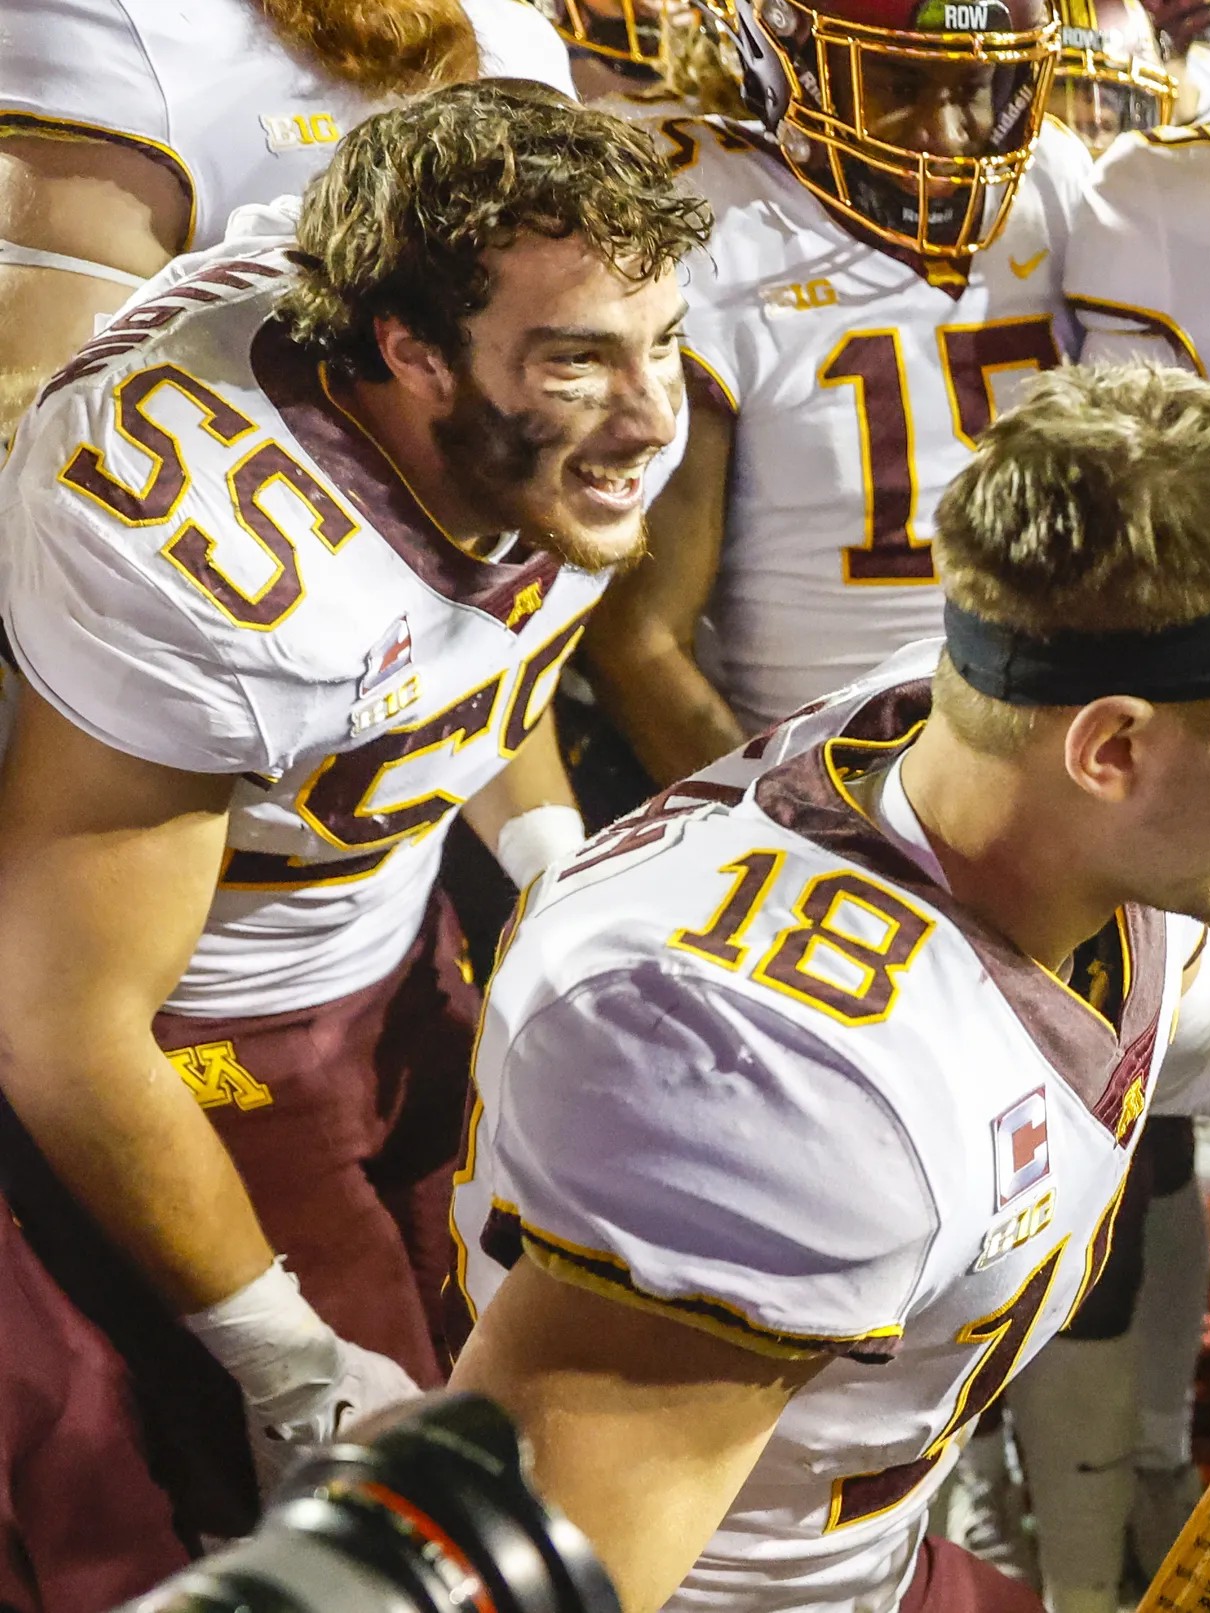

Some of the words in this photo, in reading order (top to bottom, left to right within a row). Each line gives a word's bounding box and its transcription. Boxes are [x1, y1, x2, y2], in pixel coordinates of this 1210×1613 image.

[944, 4, 988, 30] ROW
[57, 362, 361, 632] 55
[668, 847, 936, 1027] 18
[995, 1083, 1049, 1207] C
